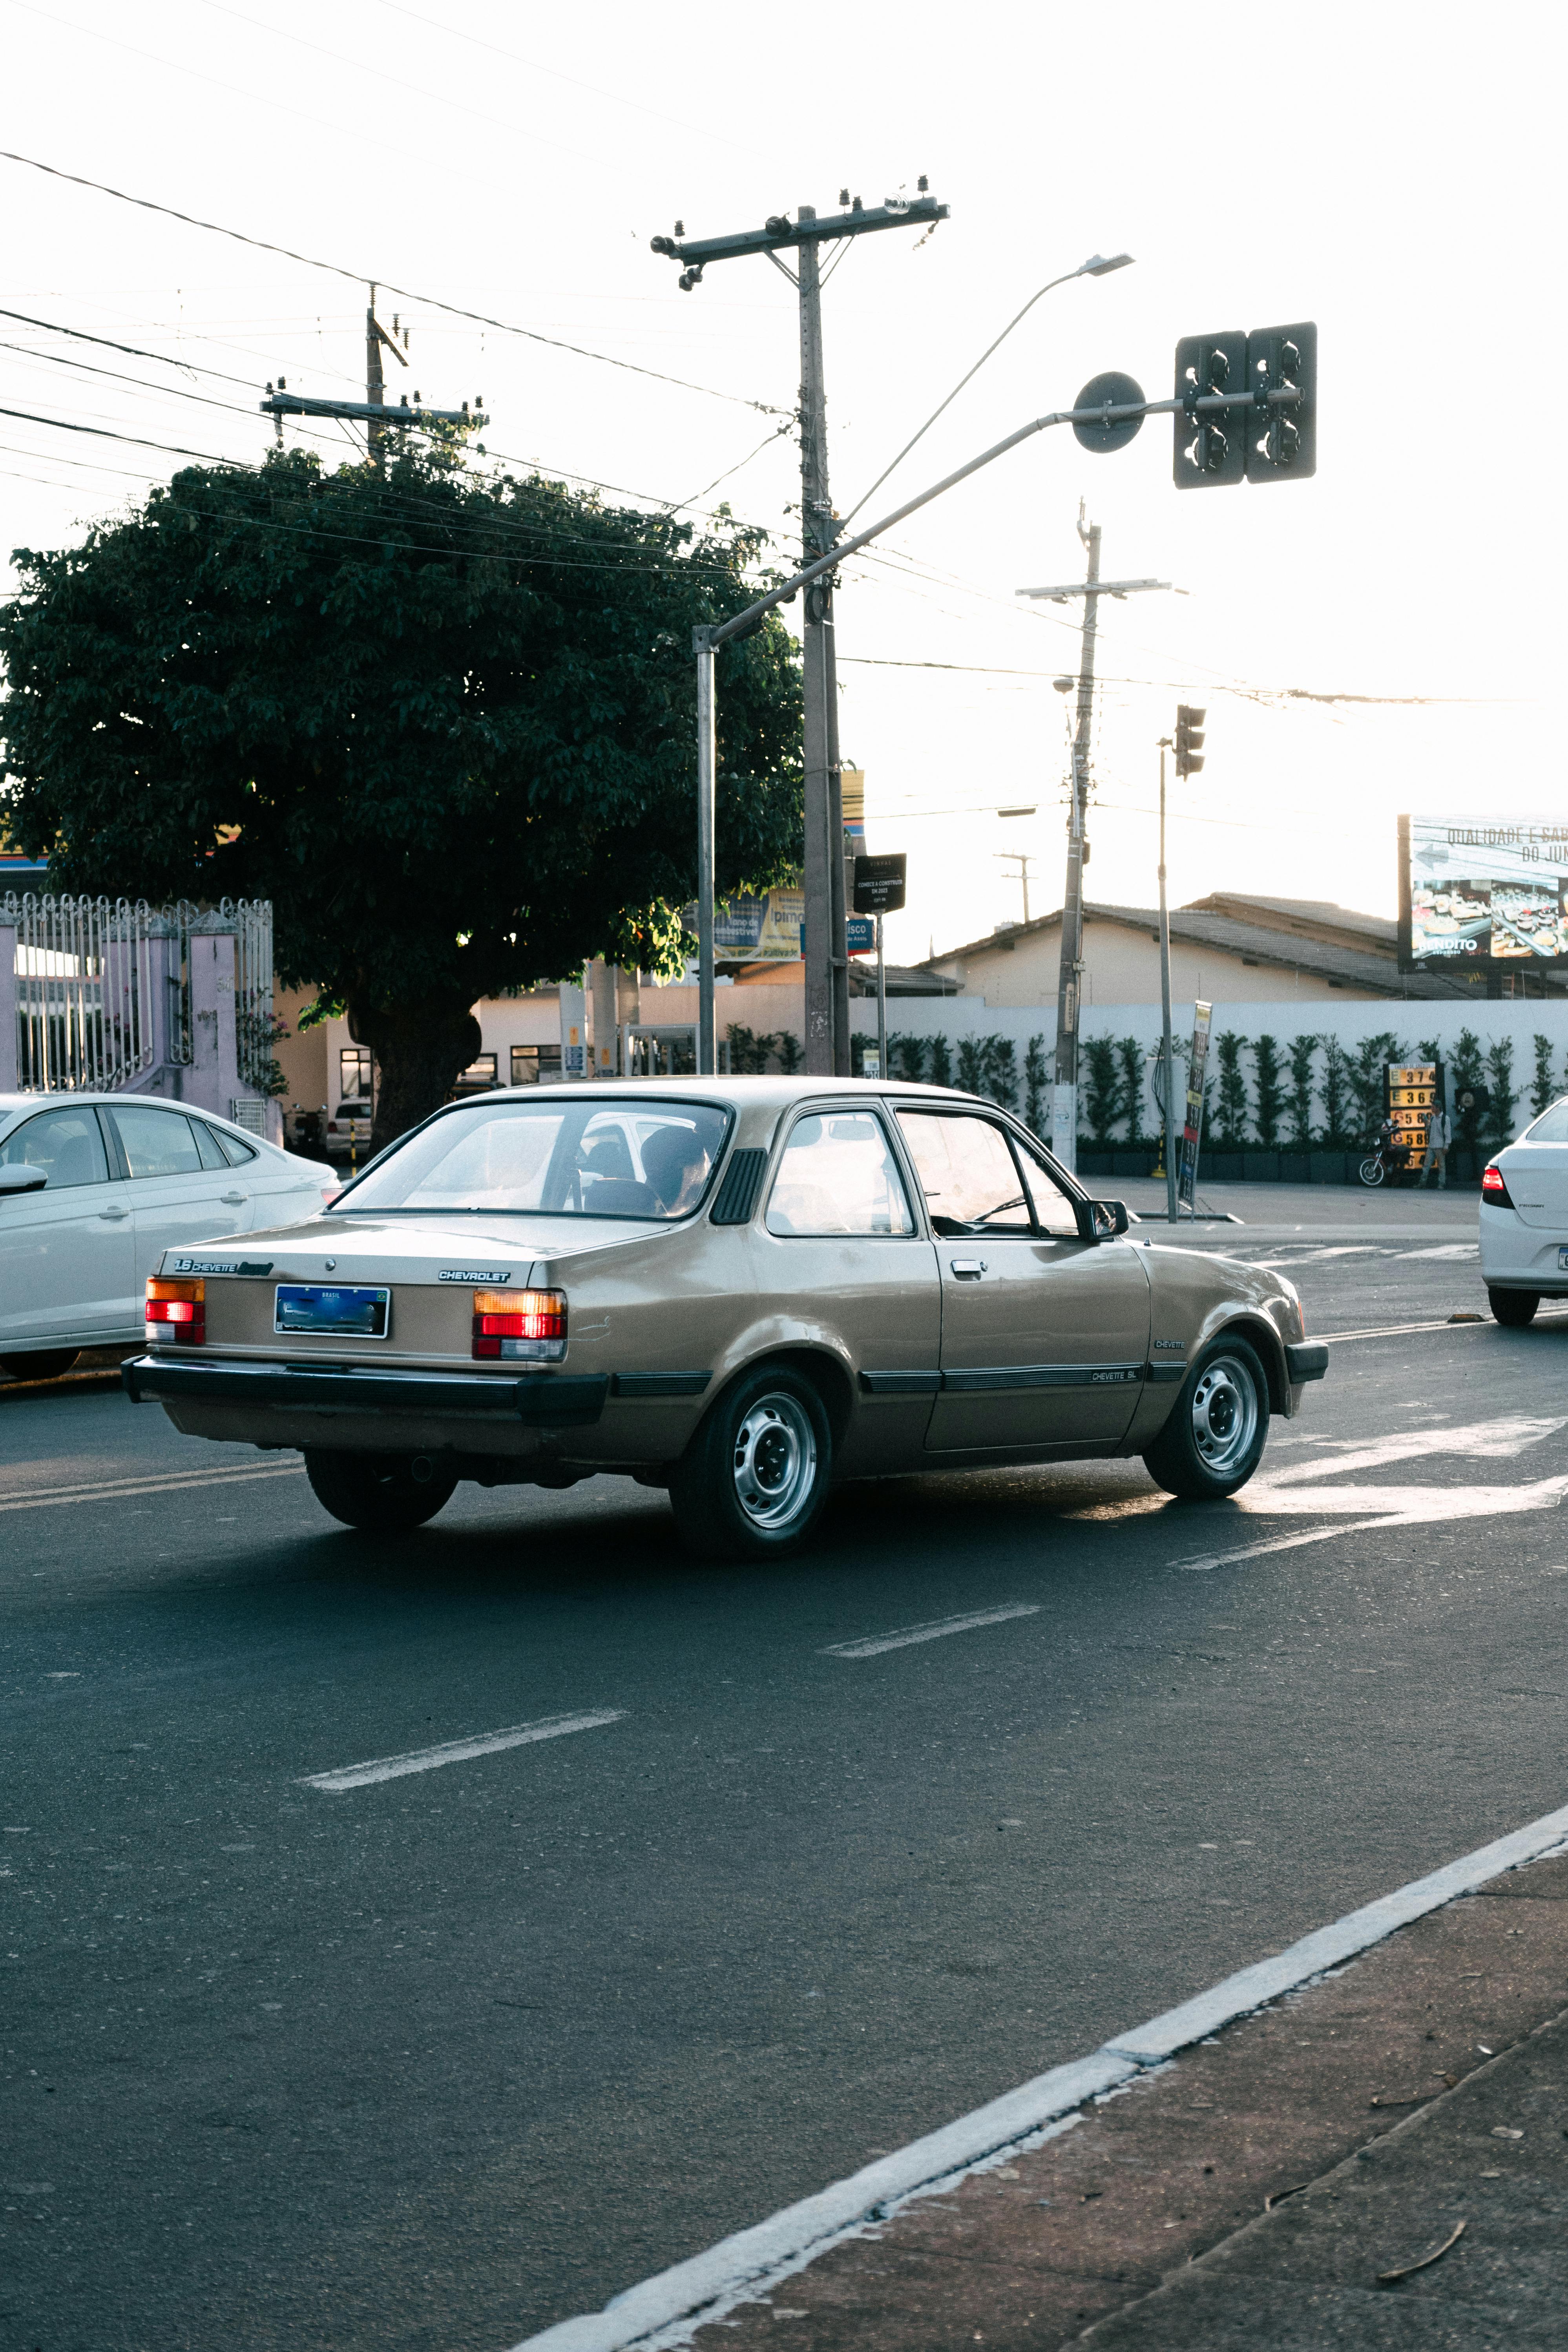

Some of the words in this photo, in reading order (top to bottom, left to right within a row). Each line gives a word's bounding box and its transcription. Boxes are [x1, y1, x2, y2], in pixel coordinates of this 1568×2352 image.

[1448, 827, 1522, 845] QUALIDADE
[1530, 828, 1536, 843] E
[1523, 846, 1539, 862] DO
[1418, 939, 1477, 951] BENDITO
[1391, 1071, 1398, 1080] E
[1393, 1091, 1400, 1101] E
[1394, 1132, 1402, 1143] G
[175, 1260, 192, 1270] 1.6
[192, 1263, 236, 1272] CHEVETTE
[439, 1271, 508, 1281] CHEVROLET
[1093, 1372, 1124, 1380] CHEVETTE
